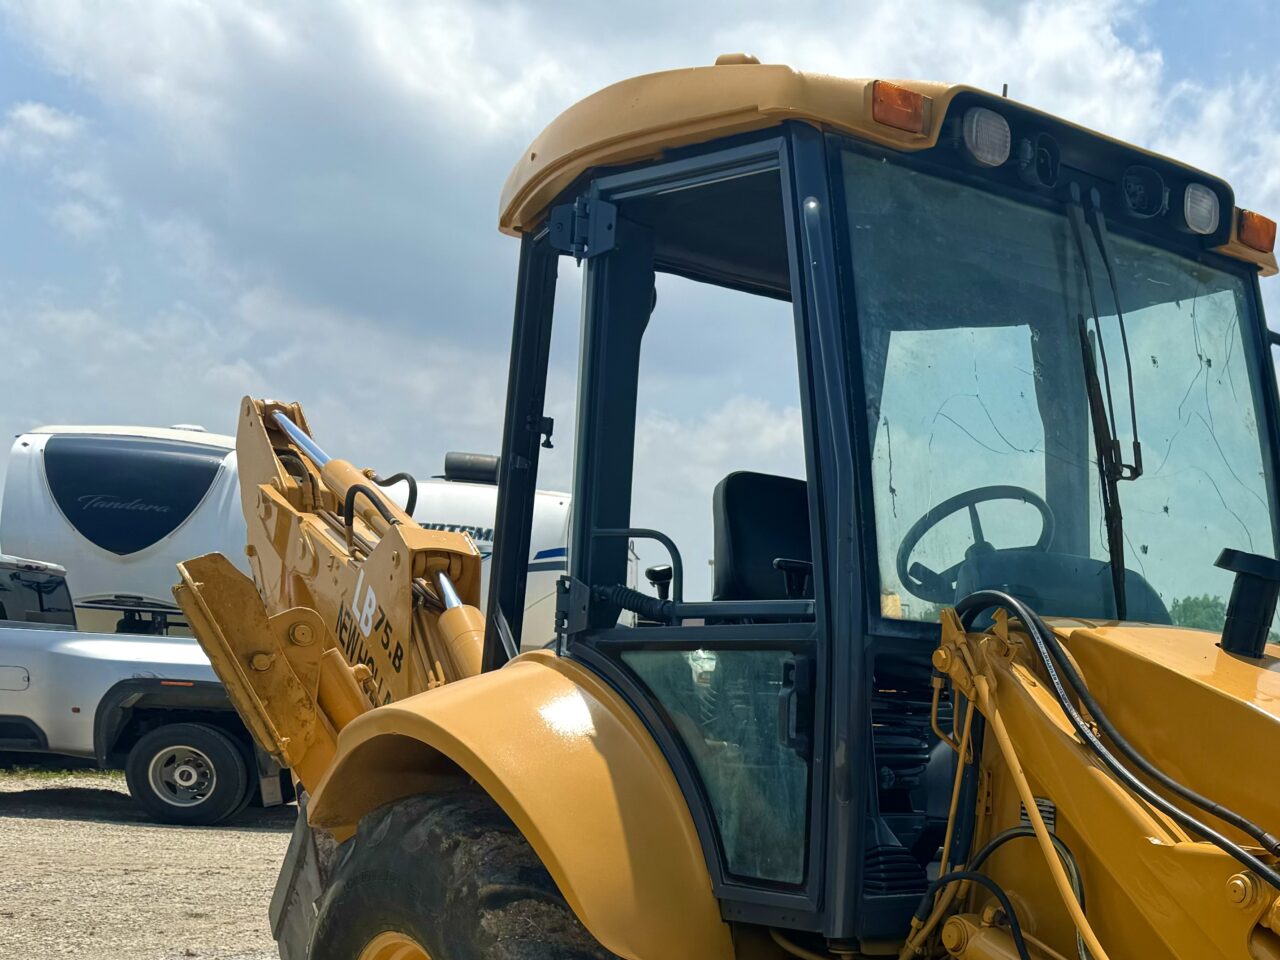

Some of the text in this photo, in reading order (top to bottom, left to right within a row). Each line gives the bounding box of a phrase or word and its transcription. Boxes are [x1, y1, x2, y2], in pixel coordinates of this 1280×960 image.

[78, 494, 169, 513] Tandara
[333, 599, 361, 663] NEW
[352, 567, 377, 638] LB
